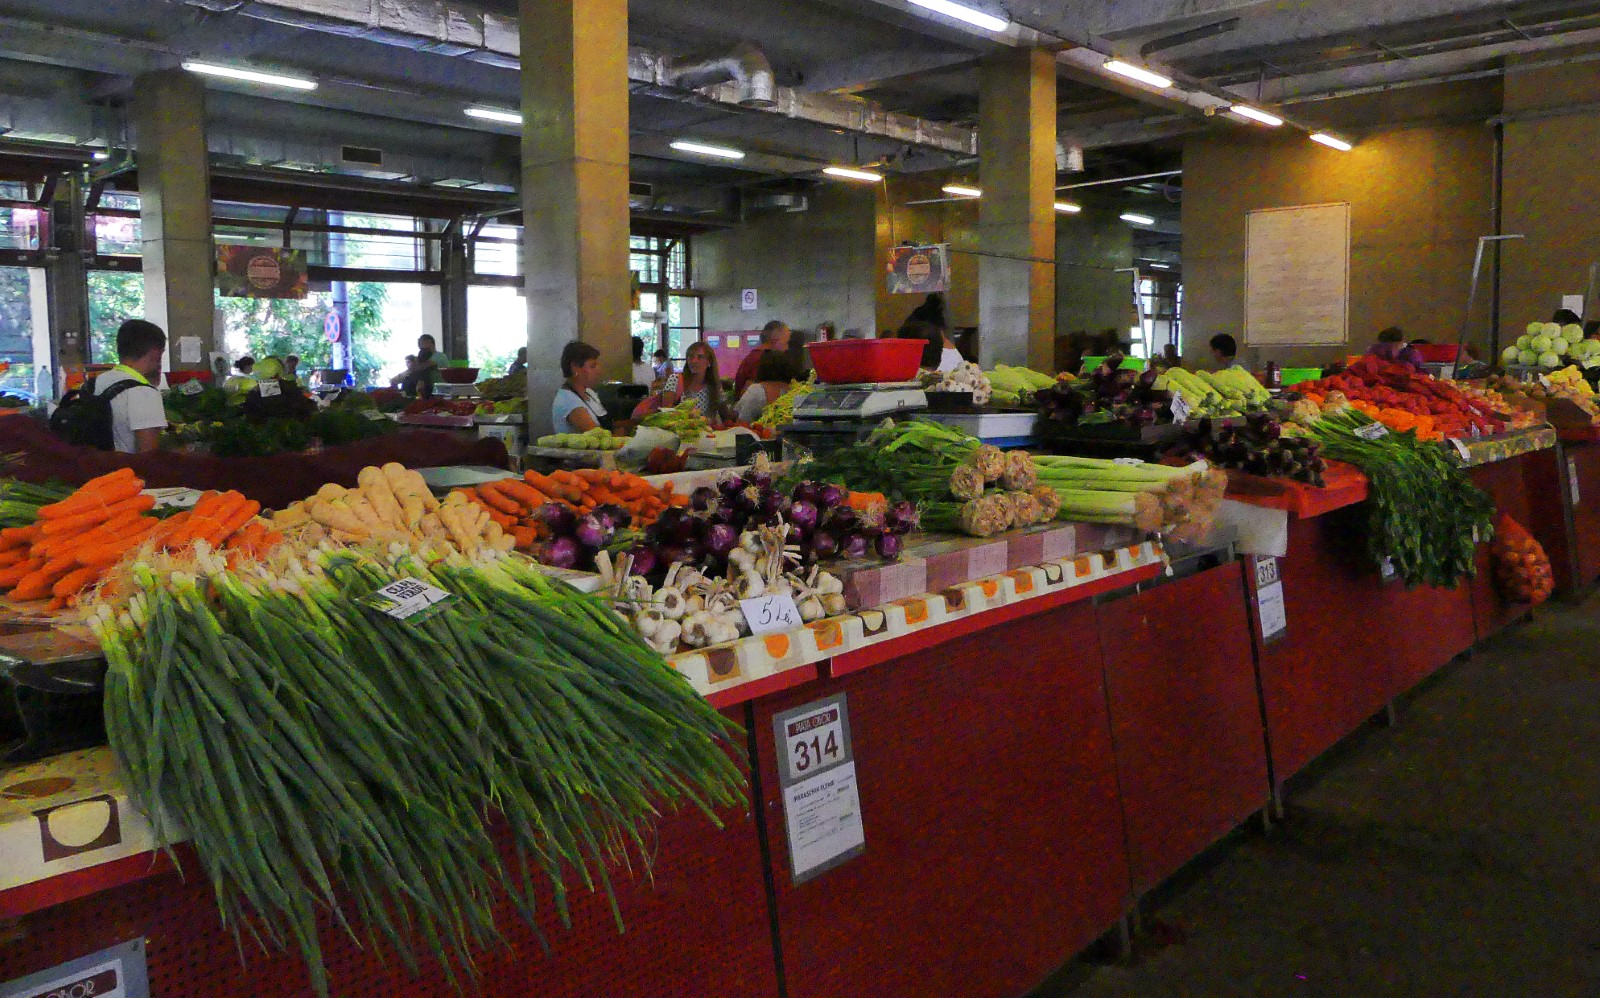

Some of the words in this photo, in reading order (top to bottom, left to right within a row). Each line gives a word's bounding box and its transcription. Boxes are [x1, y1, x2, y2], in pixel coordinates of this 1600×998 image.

[1257, 561, 1276, 583] 313
[758, 596, 774, 625] 5
[793, 729, 839, 772] 314
